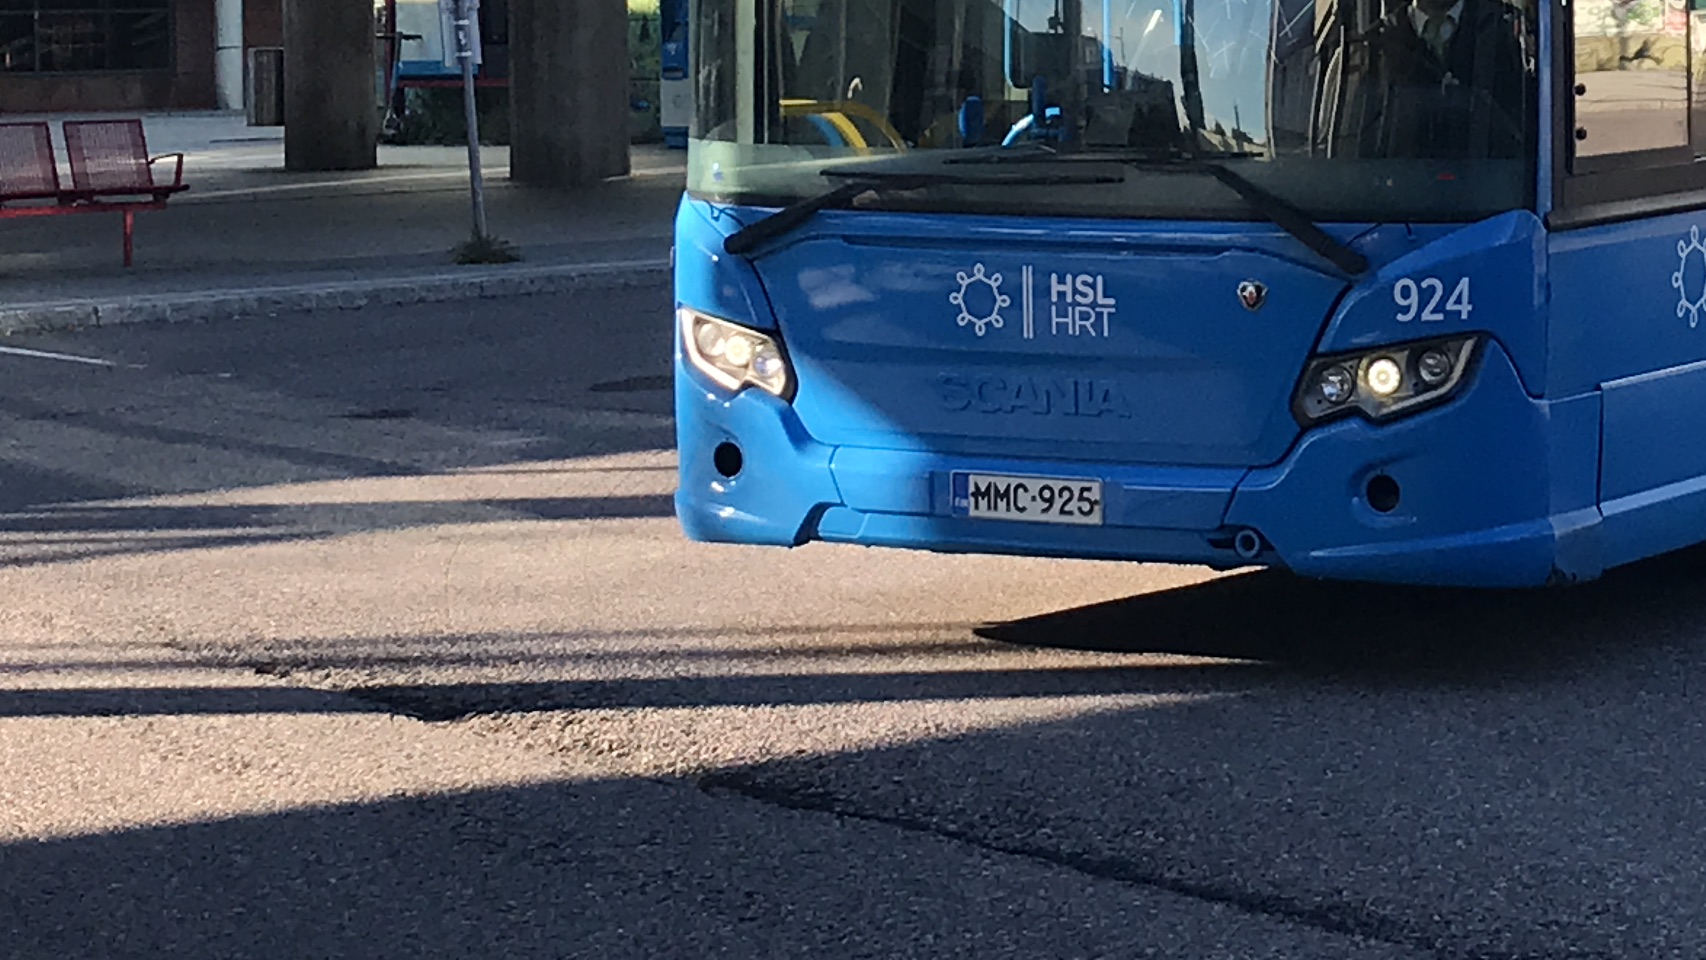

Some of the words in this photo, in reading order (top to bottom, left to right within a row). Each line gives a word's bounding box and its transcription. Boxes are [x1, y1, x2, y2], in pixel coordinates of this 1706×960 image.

[1050, 272, 1116, 305] HSL
[1393, 277, 1473, 322] 924
[1050, 304, 1116, 337] HRT
[938, 373, 1132, 419] SCANIA
[972, 481, 1097, 517] MMC-925
